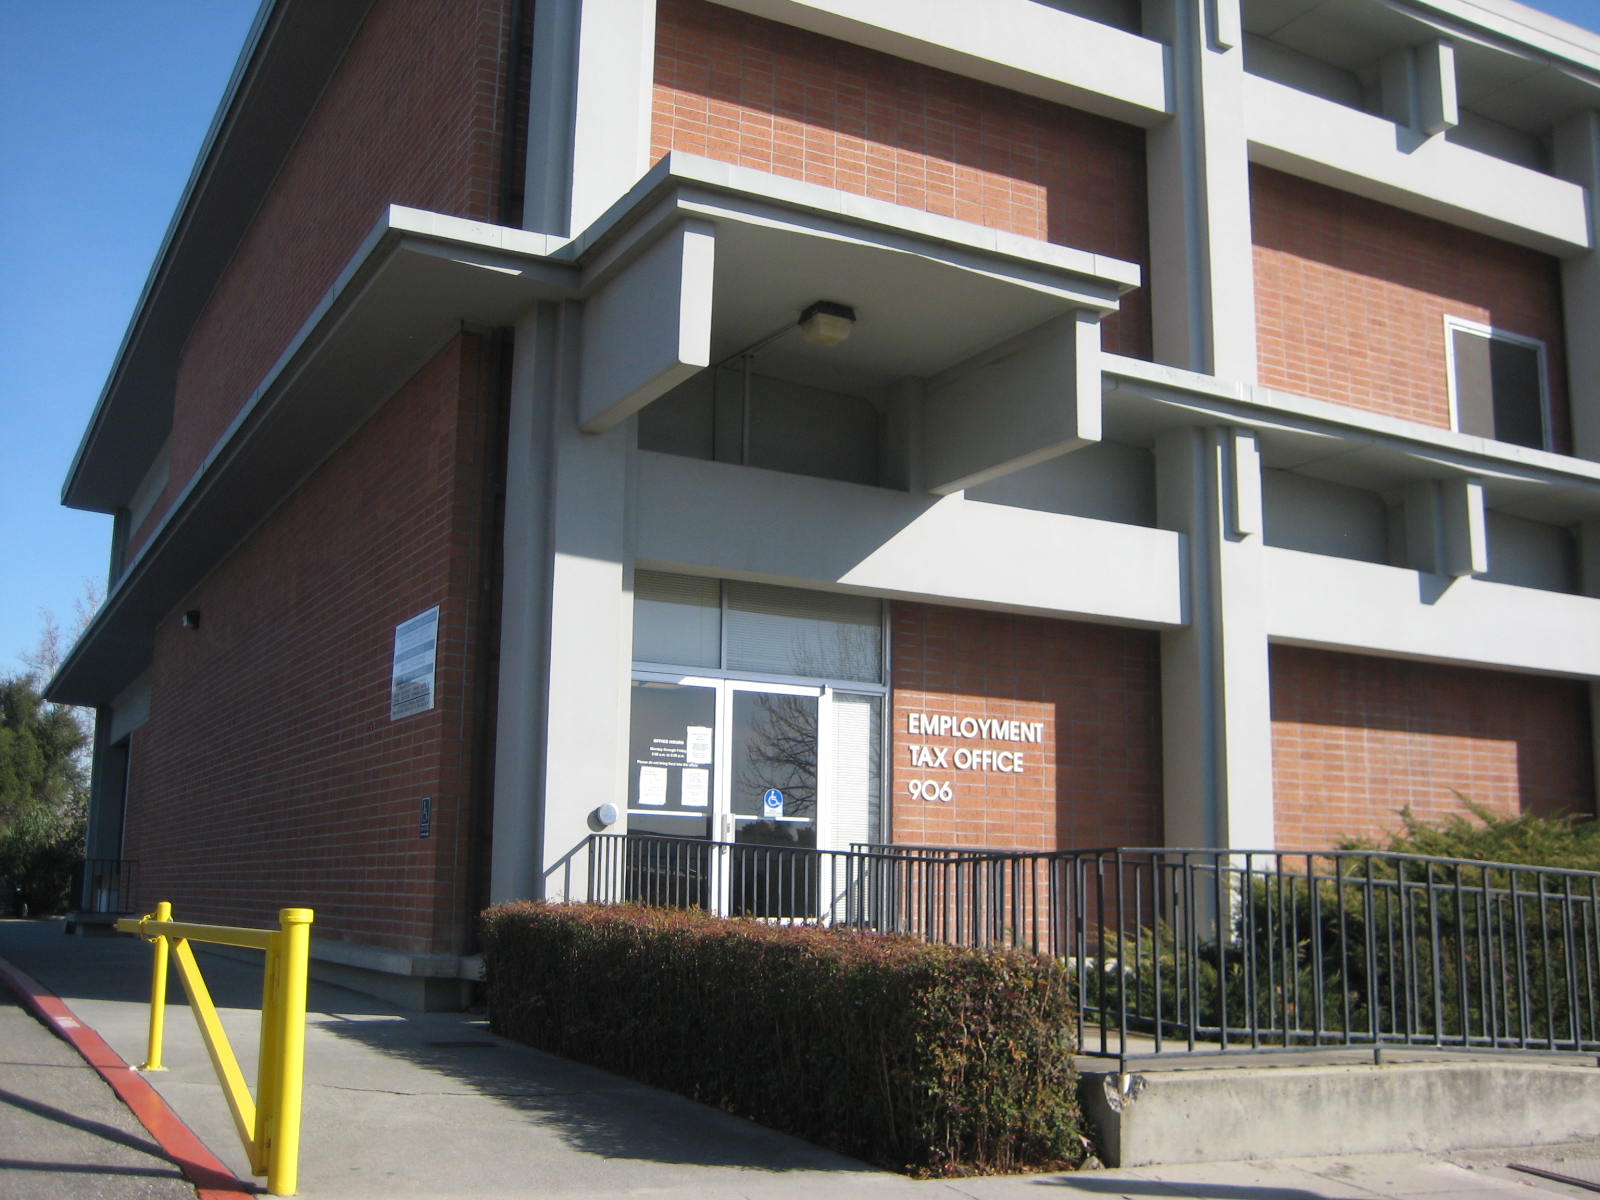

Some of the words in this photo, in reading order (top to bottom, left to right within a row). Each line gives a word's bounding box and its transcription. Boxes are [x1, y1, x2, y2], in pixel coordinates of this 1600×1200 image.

[908, 713, 1044, 743] EMPLOYMENT
[909, 745, 949, 768] TAX
[953, 748, 1024, 773] OFFICE
[908, 779, 953, 801] 906
